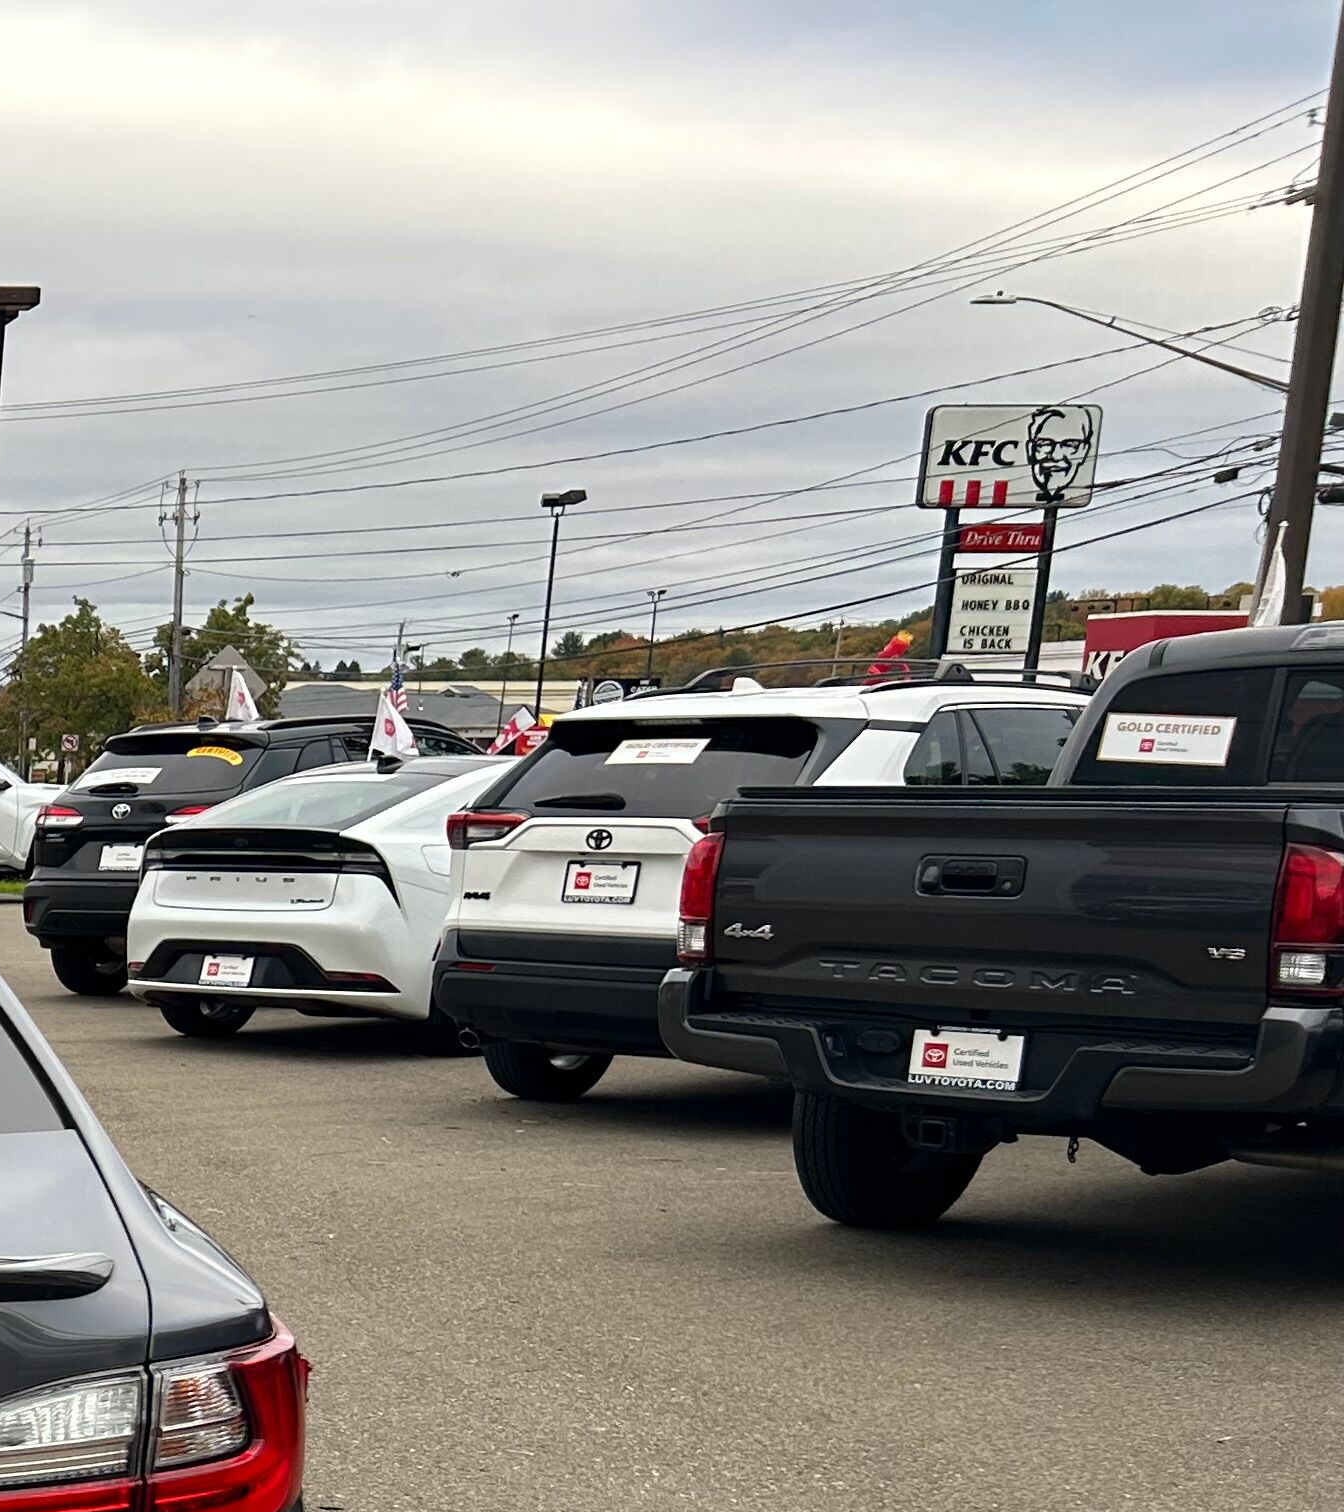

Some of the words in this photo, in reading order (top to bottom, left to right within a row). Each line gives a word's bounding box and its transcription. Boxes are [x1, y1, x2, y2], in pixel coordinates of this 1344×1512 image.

[937, 439, 1019, 466] KFC
[964, 531, 1002, 546] Drive
[1006, 531, 1041, 546] Thru
[961, 573, 1014, 585] ORIGINAL
[961, 599, 998, 611] HONEY
[1005, 599, 1030, 611] BBQ
[959, 625, 1010, 637] CHICKEN
[963, 638, 973, 649] IS
[981, 638, 1012, 650] BACK
[1085, 651, 1125, 680] KF
[1117, 721, 1154, 733] GOLD
[1155, 723, 1221, 736] CERTIFIED
[819, 959, 1138, 996] TACOMA
[953, 1048, 990, 1058] Certified
[952, 1059, 974, 1067] Used
[976, 1060, 1009, 1070] Vehicles
[907, 1073, 1016, 1091] LUVTOYOTA.COM
